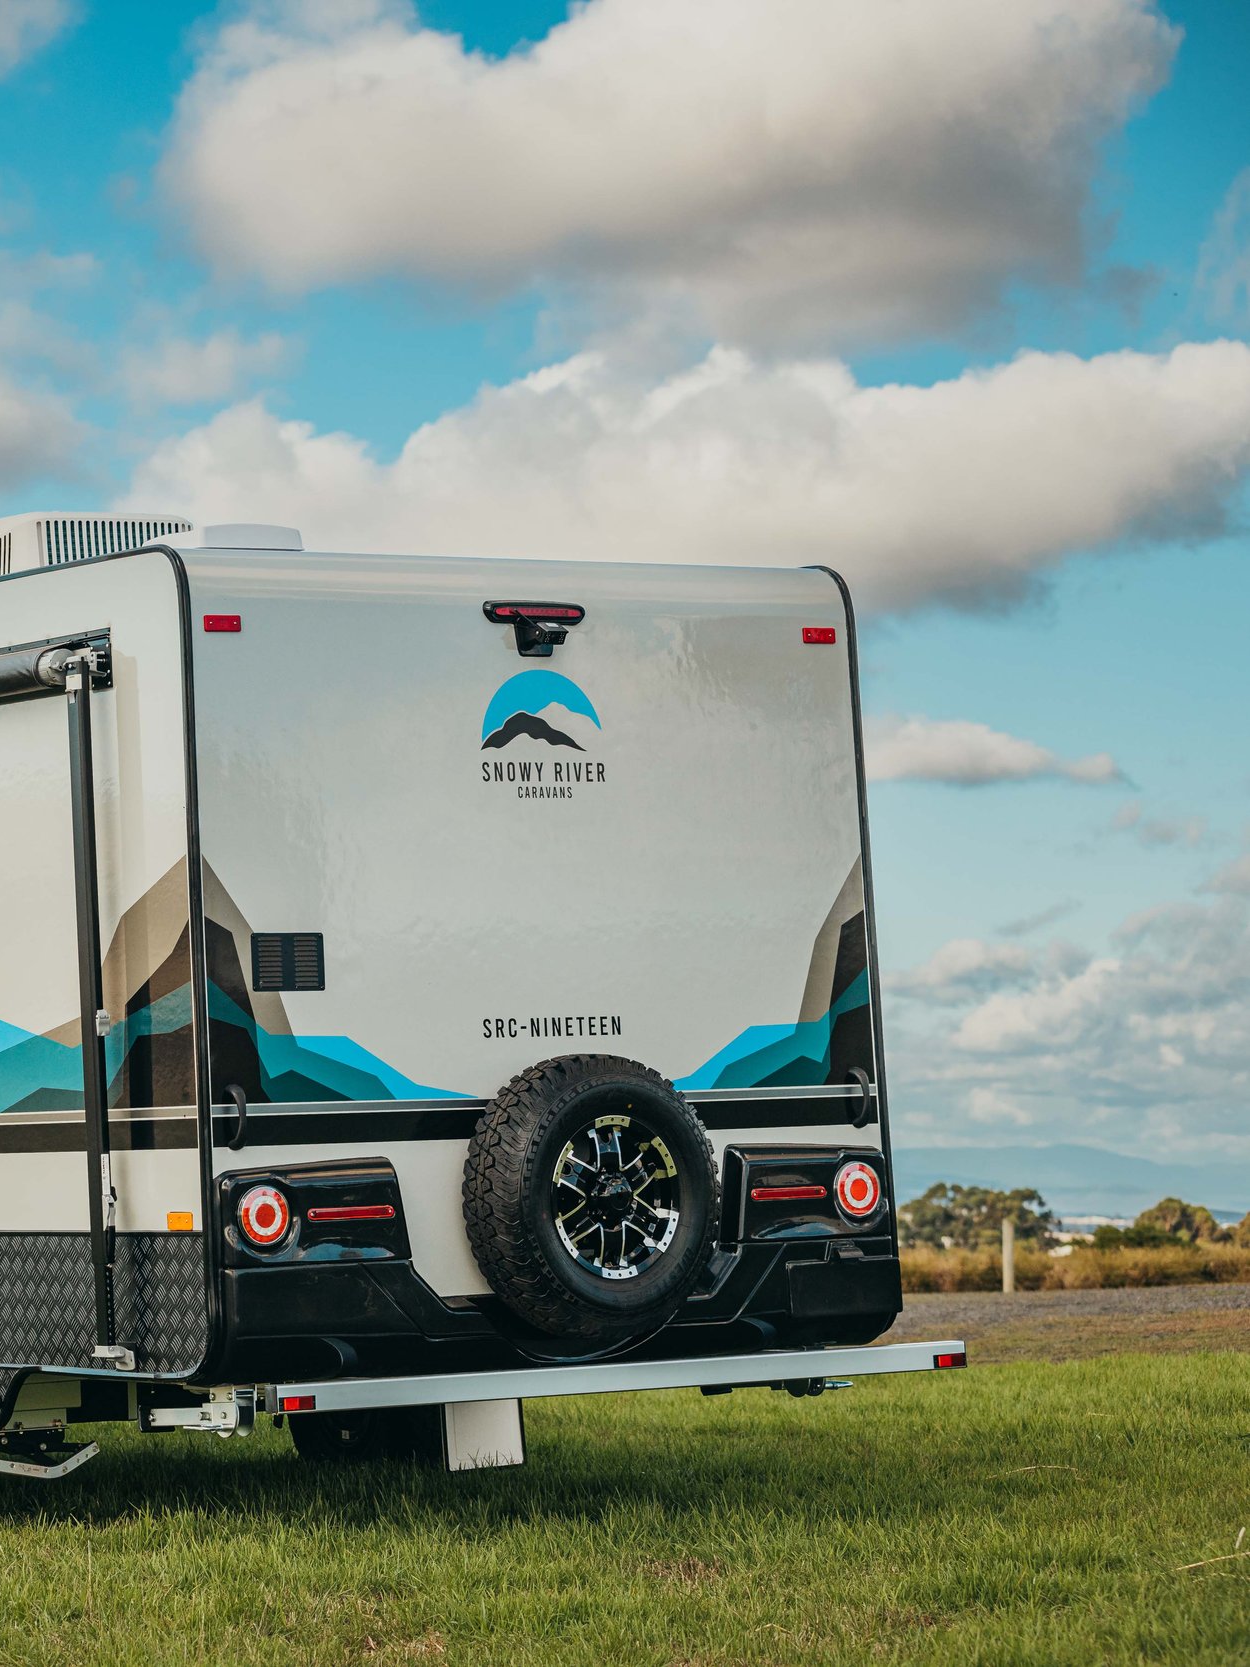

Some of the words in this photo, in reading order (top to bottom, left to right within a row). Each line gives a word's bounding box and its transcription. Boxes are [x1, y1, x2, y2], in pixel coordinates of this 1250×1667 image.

[481, 761, 544, 783] SNOWY
[554, 762, 606, 783] RIVER
[517, 786, 573, 799] CARAVANS
[482, 1015, 622, 1039] SRC-NINETEEN
